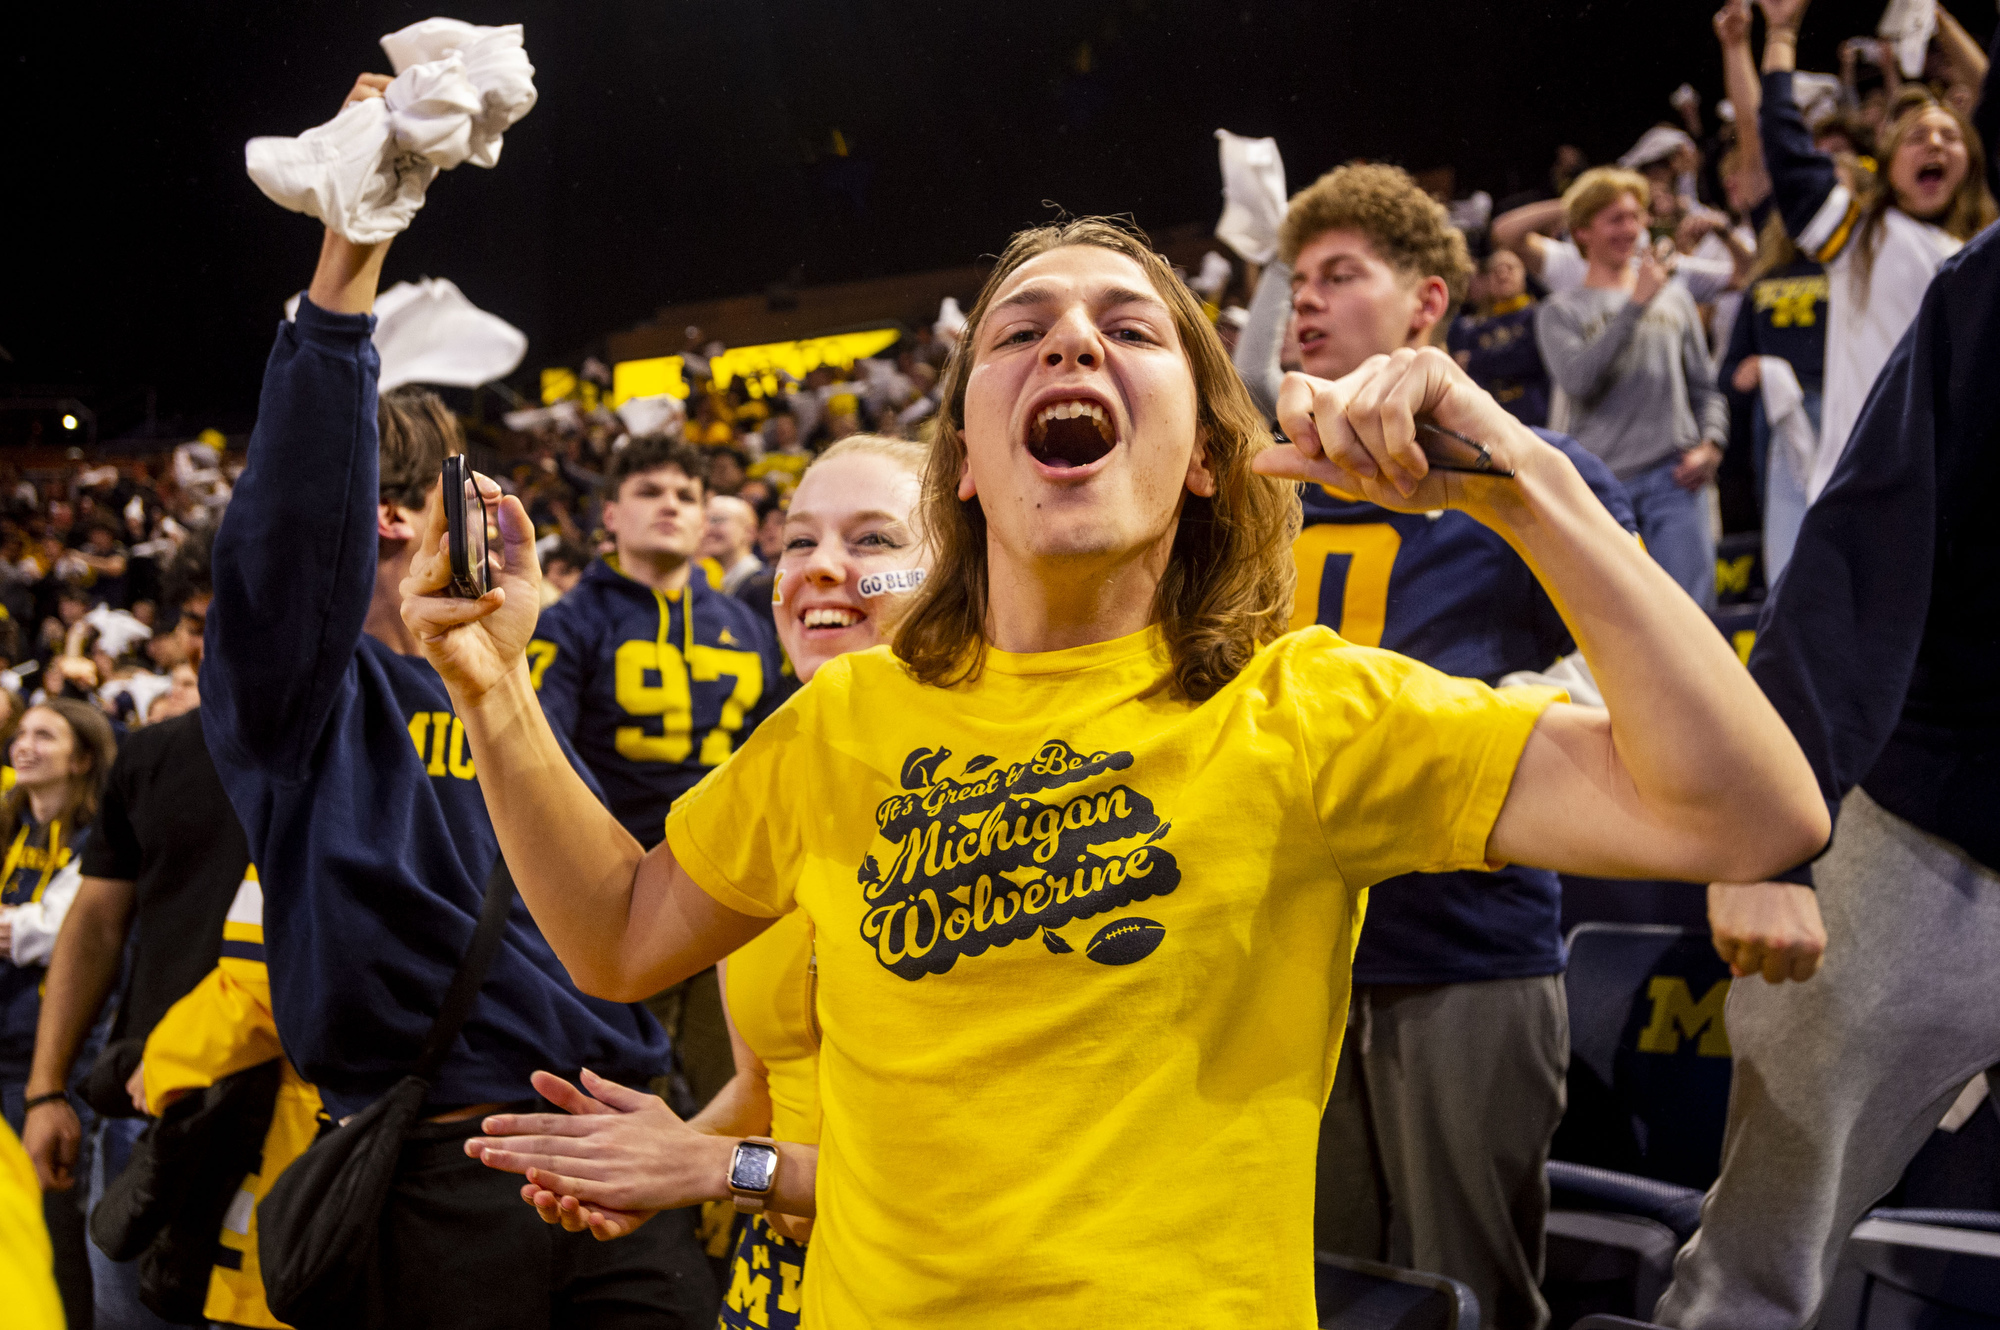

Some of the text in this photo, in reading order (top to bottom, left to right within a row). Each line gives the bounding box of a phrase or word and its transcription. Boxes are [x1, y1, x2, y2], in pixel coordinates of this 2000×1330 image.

[861, 575, 882, 594] GO
[615, 639, 763, 766] 97
[878, 794, 914, 830] It's
[921, 772, 999, 817] Great
[1005, 766, 1025, 788] to
[1031, 744, 1084, 776] Be
[866, 789, 1133, 900] Michigan
[861, 849, 1155, 966] Wolverine
[1637, 975, 1732, 1057] M
[725, 1256, 772, 1329] M
